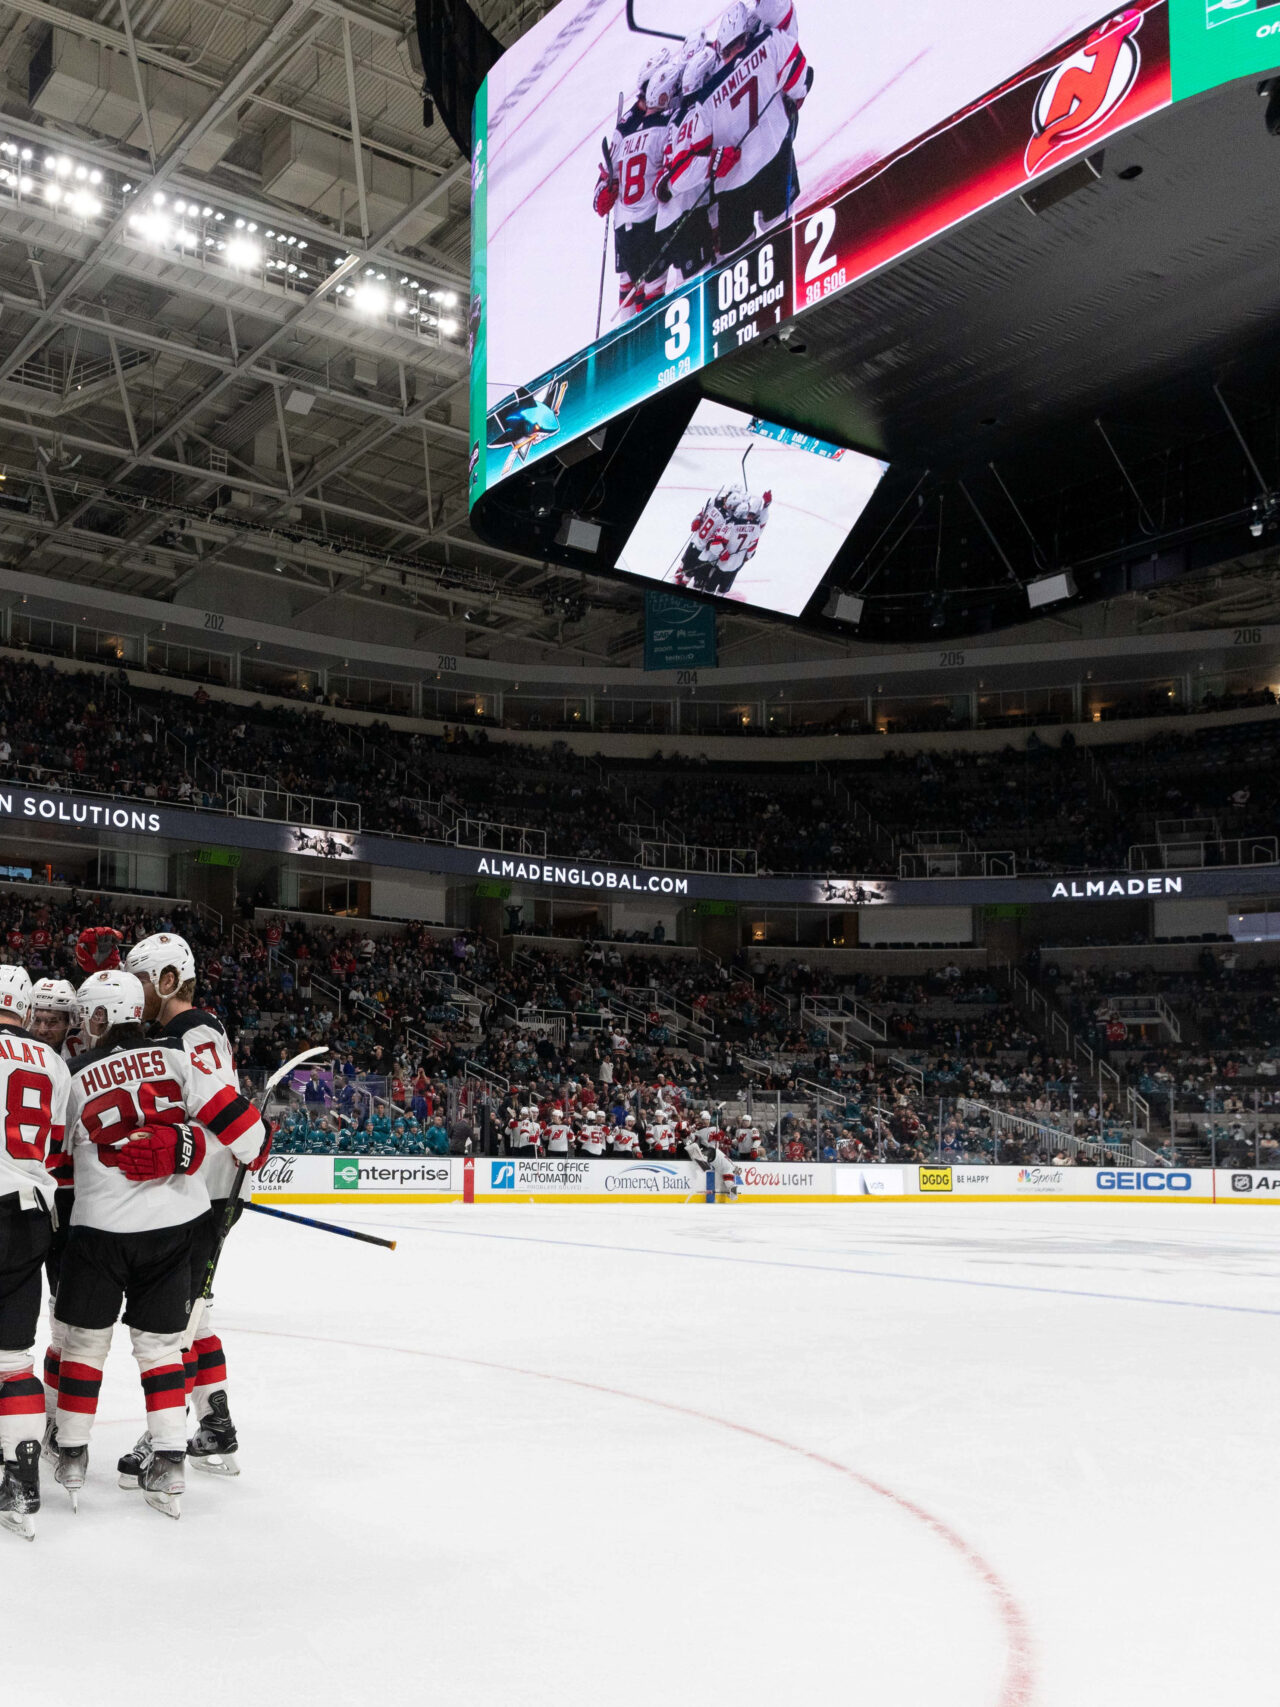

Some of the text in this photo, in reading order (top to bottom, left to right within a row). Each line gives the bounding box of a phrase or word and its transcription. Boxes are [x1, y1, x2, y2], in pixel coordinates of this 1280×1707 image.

[713, 45, 767, 108] HAMILTON
[730, 75, 758, 130] 7
[804, 208, 838, 283] 2
[718, 244, 774, 311] 08.6
[824, 268, 846, 294] SOG
[712, 281, 784, 336] 3RD Period
[664, 297, 690, 361] 3
[736, 323, 759, 345] TOL
[658, 366, 676, 387] SOG
[204, 613, 224, 631] 202
[1233, 628, 1261, 645] 206
[438, 655, 457, 671] 203
[939, 651, 964, 667] 205
[677, 671, 698, 685] 204
[23, 797, 161, 831] SOLUTIONS
[477, 858, 688, 894] ALMADENGLOBAL.COM
[1051, 877, 1182, 897] ALMADEN
[80, 1050, 167, 1096] HUGHES
[339, 1165, 449, 1184] enterprise
[518, 1162, 589, 1172] PACIFIC OFFICE
[745, 1167, 813, 1186] Coors LIGHT
[1031, 1168, 1063, 1185] Sports
[518, 1173, 583, 1184] AUTOMATION
[662, 1176, 690, 1189] Bank
[922, 1174, 950, 1185] DGDG
[956, 1175, 989, 1183] BE HAPPY
[1095, 1171, 1192, 1190] GEICO
